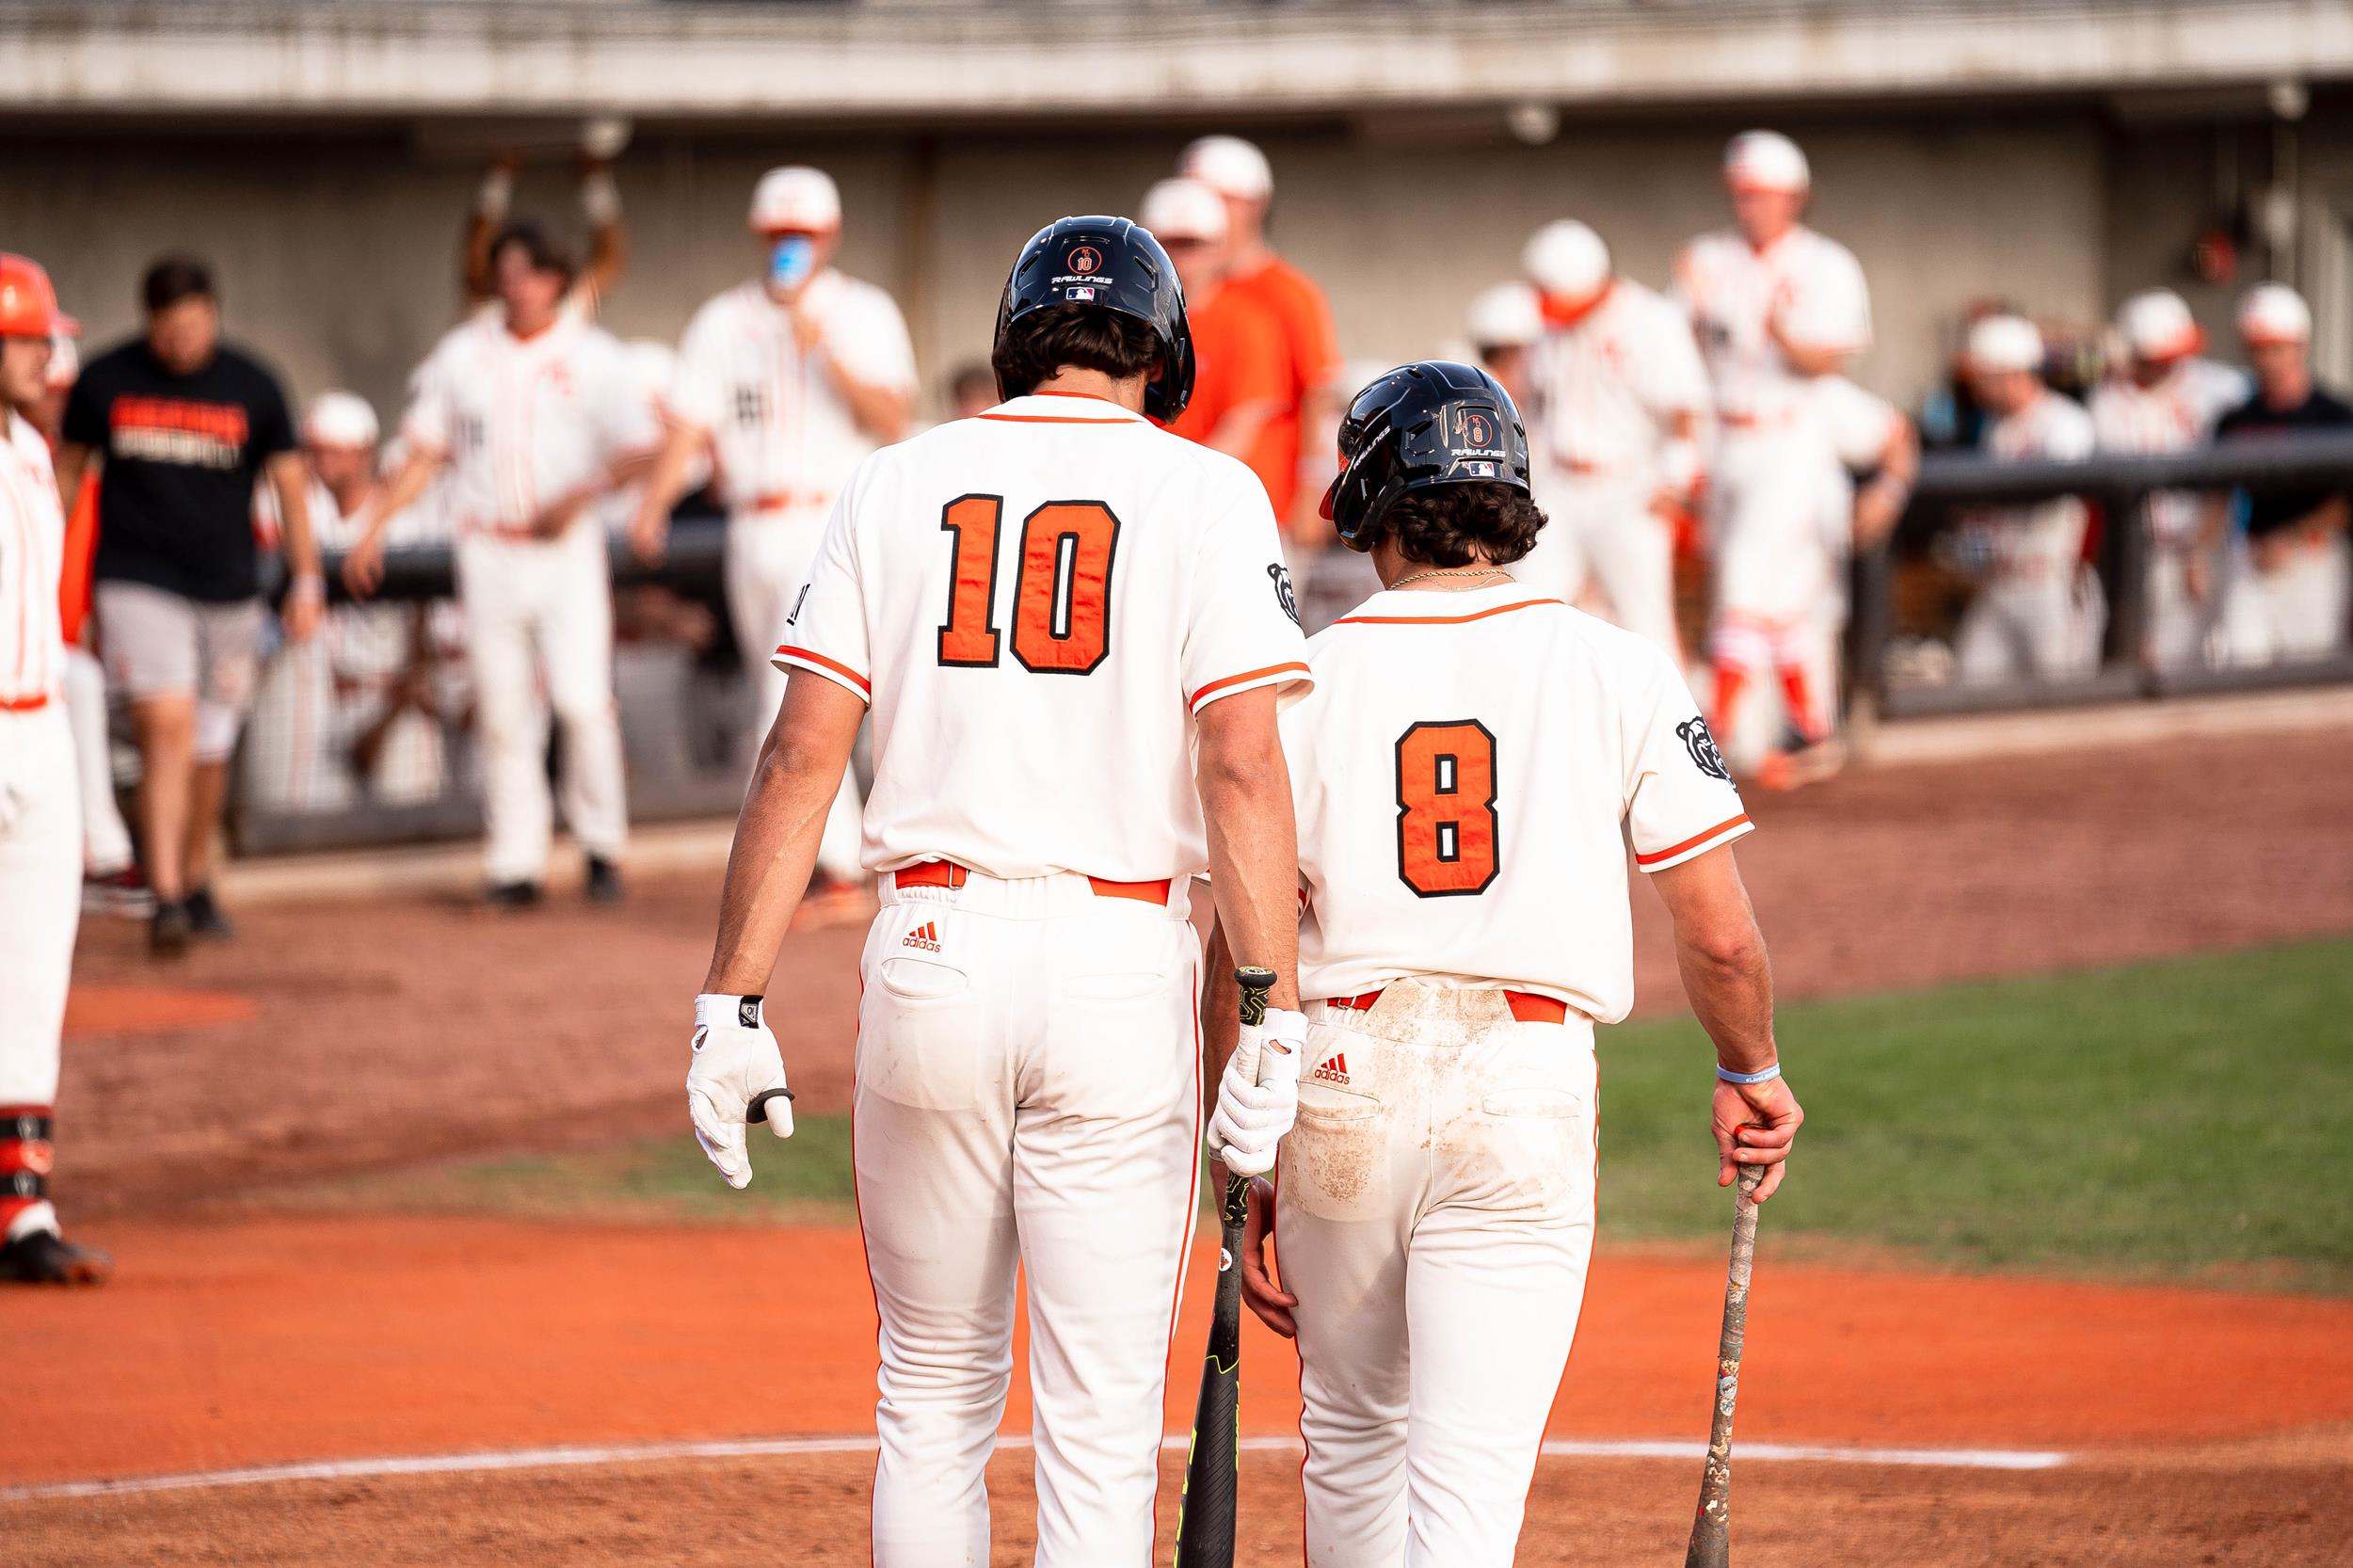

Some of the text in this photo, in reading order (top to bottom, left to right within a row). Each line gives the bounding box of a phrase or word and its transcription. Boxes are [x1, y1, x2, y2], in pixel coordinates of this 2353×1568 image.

[1078, 257, 1092, 271] 10
[1051, 275, 1113, 284] RAWLINGS
[1473, 426, 1483, 442] 8
[1450, 448, 1506, 457] RAWLINGS
[937, 493, 1121, 676] 10
[1395, 718, 1500, 899] 8
[902, 936, 941, 953] adidas
[1314, 1068, 1351, 1085] adidas
